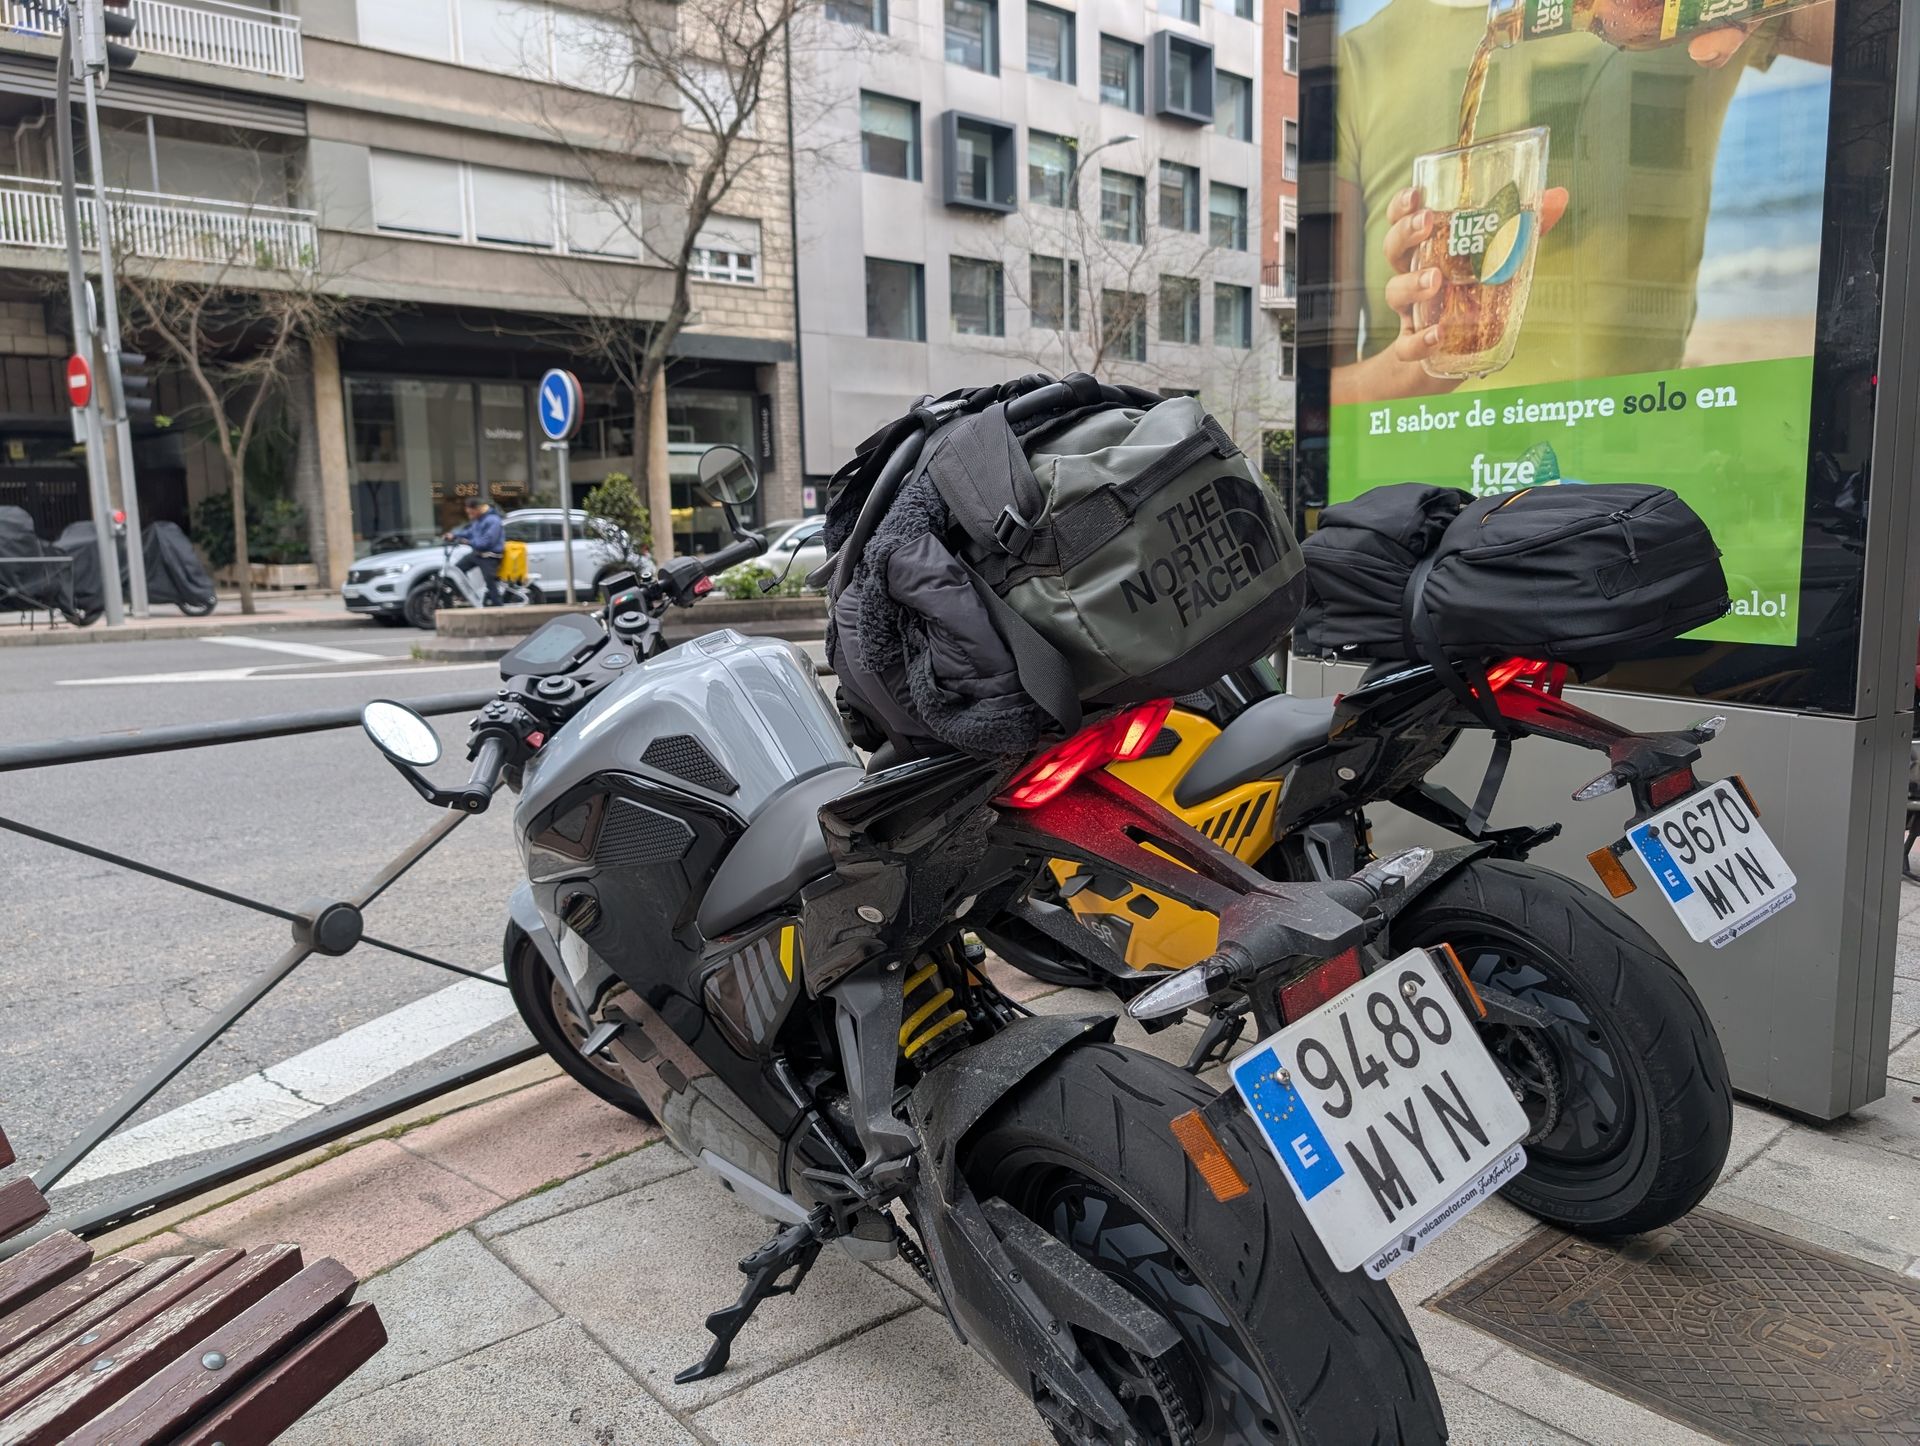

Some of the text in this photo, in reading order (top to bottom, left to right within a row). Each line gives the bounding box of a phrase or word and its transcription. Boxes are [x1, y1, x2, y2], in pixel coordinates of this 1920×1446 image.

[1447, 235, 1484, 256] tea
[1449, 211, 1499, 238] fuze
[1369, 381, 1738, 435] El sabor de siempre solo en
[1471, 453, 1535, 491] fuze
[1156, 483, 1223, 545] THE
[1119, 518, 1237, 614] NORTH
[1172, 551, 1251, 628] FACE
[1730, 590, 1786, 617] alo!
[1663, 789, 1750, 865] 9670
[1663, 869, 1680, 888] E
[1693, 847, 1775, 920] MYN
[1296, 970, 1452, 1119] 9486
[1291, 1133, 1320, 1169] E
[1344, 1070, 1490, 1224] MYN
[1372, 1246, 1401, 1273] velca
[1417, 1187, 1478, 1238] velcamotor.com
